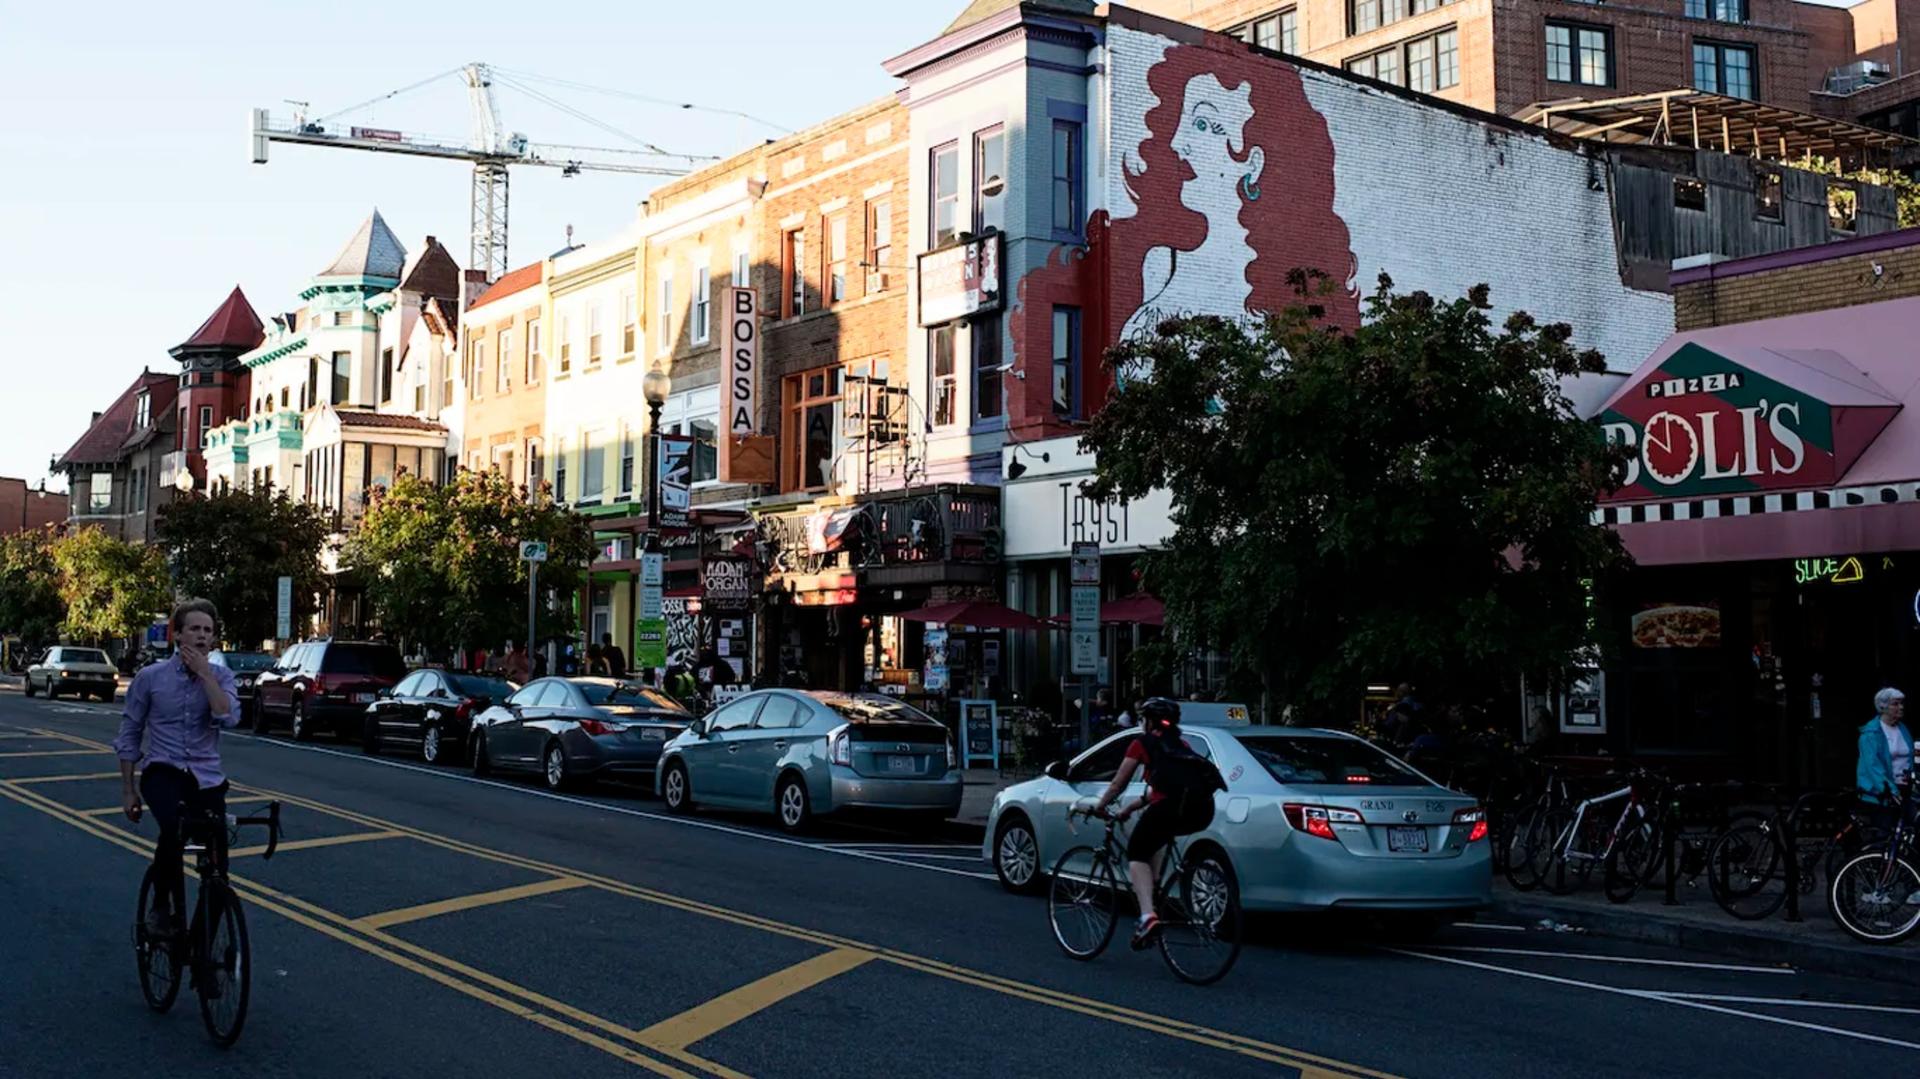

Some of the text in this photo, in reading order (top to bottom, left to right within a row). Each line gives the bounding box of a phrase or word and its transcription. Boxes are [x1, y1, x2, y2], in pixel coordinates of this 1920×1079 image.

[733, 290, 754, 430] BOSSA
[1650, 374, 1741, 398] PIZZA
[1600, 398, 1806, 487] BOLI'S
[705, 576, 750, 591] ORGAN
[1360, 799, 1395, 810] GRAND
